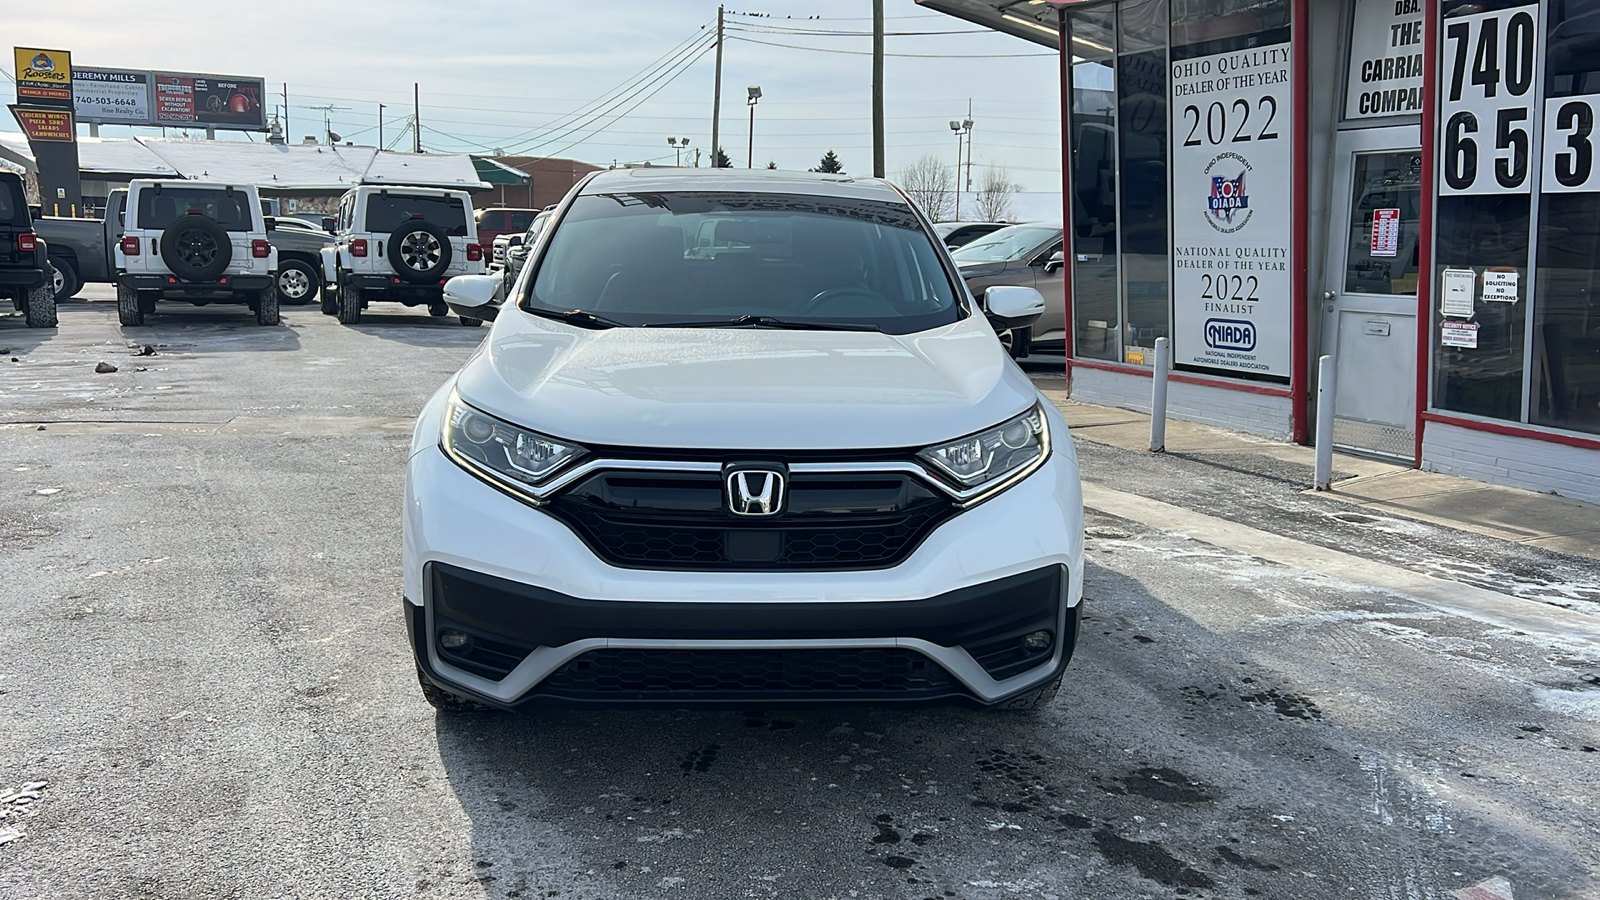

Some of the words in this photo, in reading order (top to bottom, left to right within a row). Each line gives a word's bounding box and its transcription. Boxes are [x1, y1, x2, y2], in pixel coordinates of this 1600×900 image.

[1391, 21, 1422, 47] THE
[1173, 60, 1211, 79] OHIO
[1218, 47, 1290, 74] QUALITY
[1447, 11, 1535, 102] 740
[23, 67, 66, 80] Roosters
[73, 71, 108, 80] JEREMY
[109, 74, 136, 82] MILLS
[1175, 80, 1214, 97] DEALER
[1216, 77, 1230, 91] OF
[1233, 74, 1255, 89] THE
[1257, 69, 1288, 85] YEAR
[75, 96, 136, 106] 740-503-6648
[21, 111, 46, 119] CHICKEN
[116, 108, 134, 116] Realty
[1183, 95, 1279, 147] 2022
[1204, 158, 1217, 175] OHIO
[1216, 152, 1254, 172] INDEPENDENT
[1212, 197, 1242, 209] OIADA
[1176, 246, 1231, 257] NATIONAL
[1235, 247, 1288, 259] QUALITY
[1177, 259, 1213, 269] DEALER
[1217, 261, 1230, 269] OF
[1233, 261, 1254, 270] THE
[1258, 262, 1286, 271] YEAR
[1201, 273, 1259, 302] 2022
[1205, 302, 1254, 314] FINALIST
[1208, 324, 1252, 345] NIADA
[1205, 350, 1226, 358] NATIONAL
[1226, 352, 1257, 361] INDEPENDENT
[1193, 356, 1219, 365] AUTOMOBILE
[1220, 359, 1239, 367] DEALERS
[1239, 362, 1270, 371] ASSOCIATION
